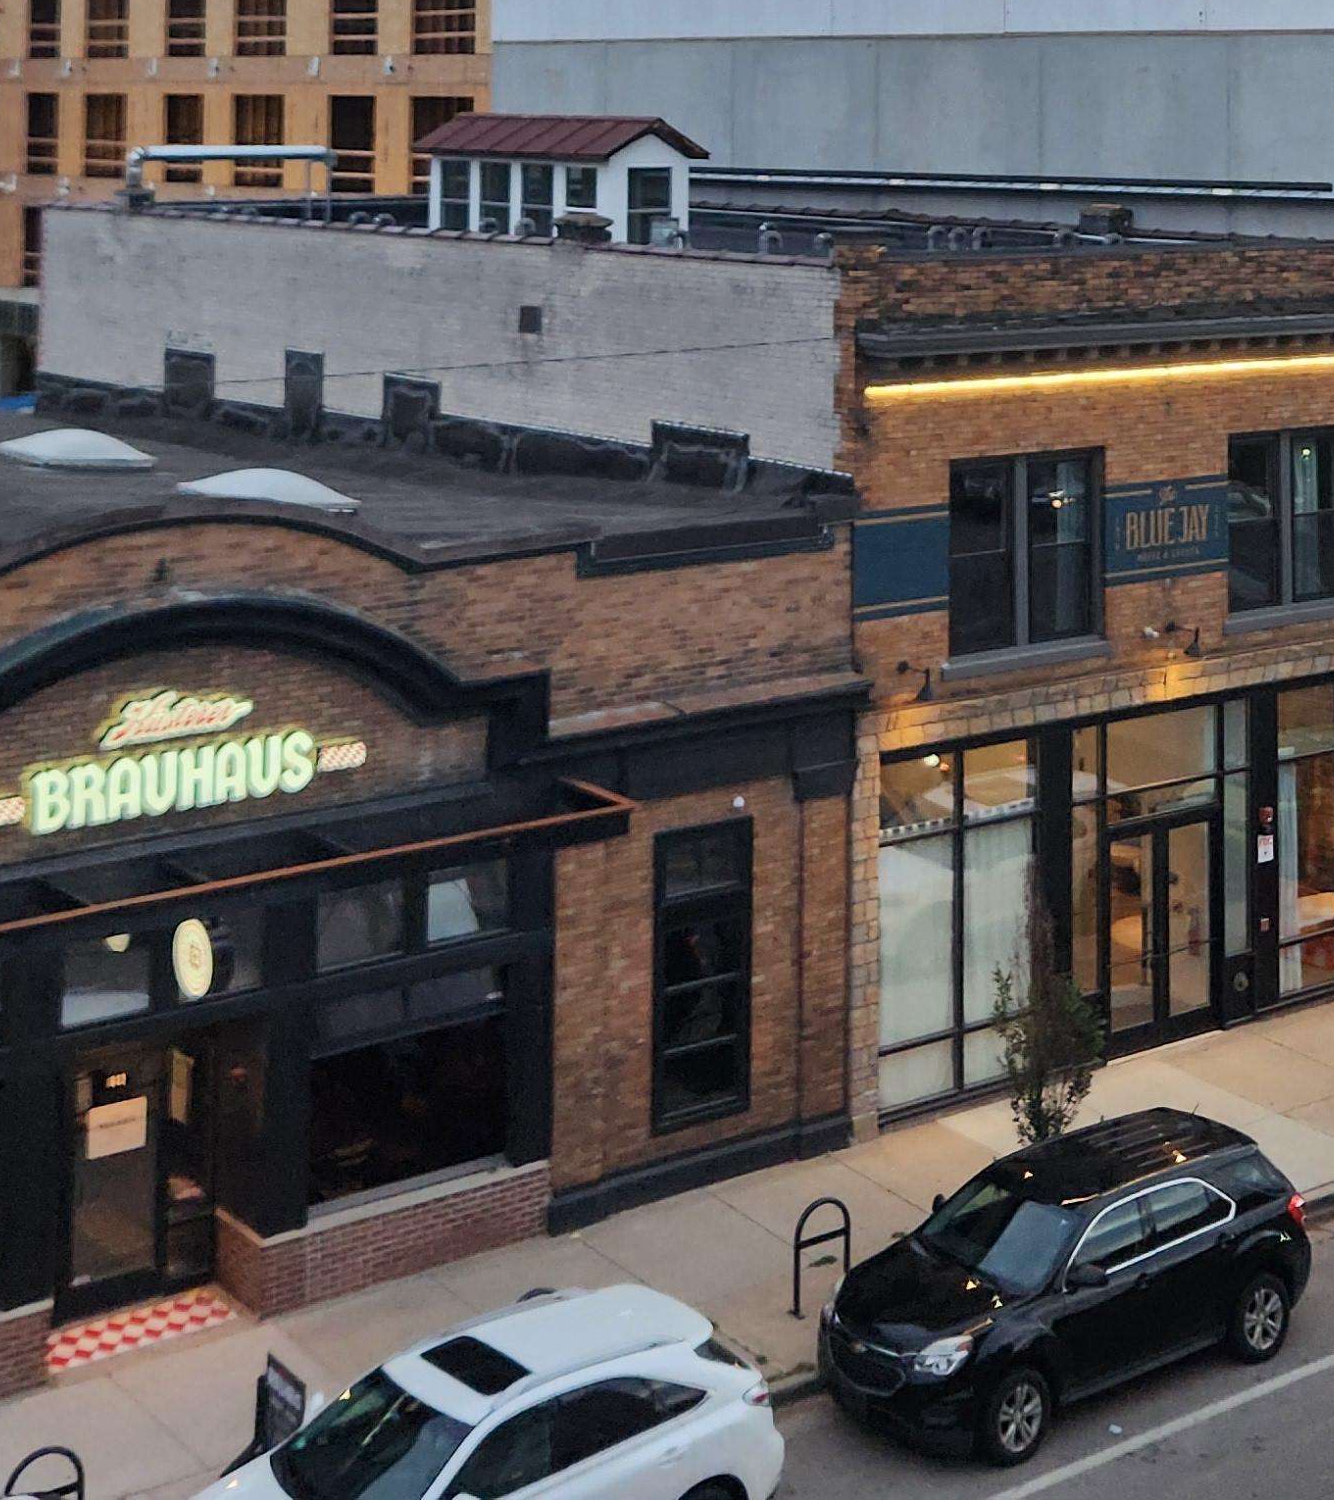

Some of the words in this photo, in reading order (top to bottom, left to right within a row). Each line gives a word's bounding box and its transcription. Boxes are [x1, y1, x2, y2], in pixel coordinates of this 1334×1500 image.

[1126, 507, 1175, 550] BLUE
[1178, 504, 1210, 543] JAY
[31, 729, 315, 836] BRAUHAUS
